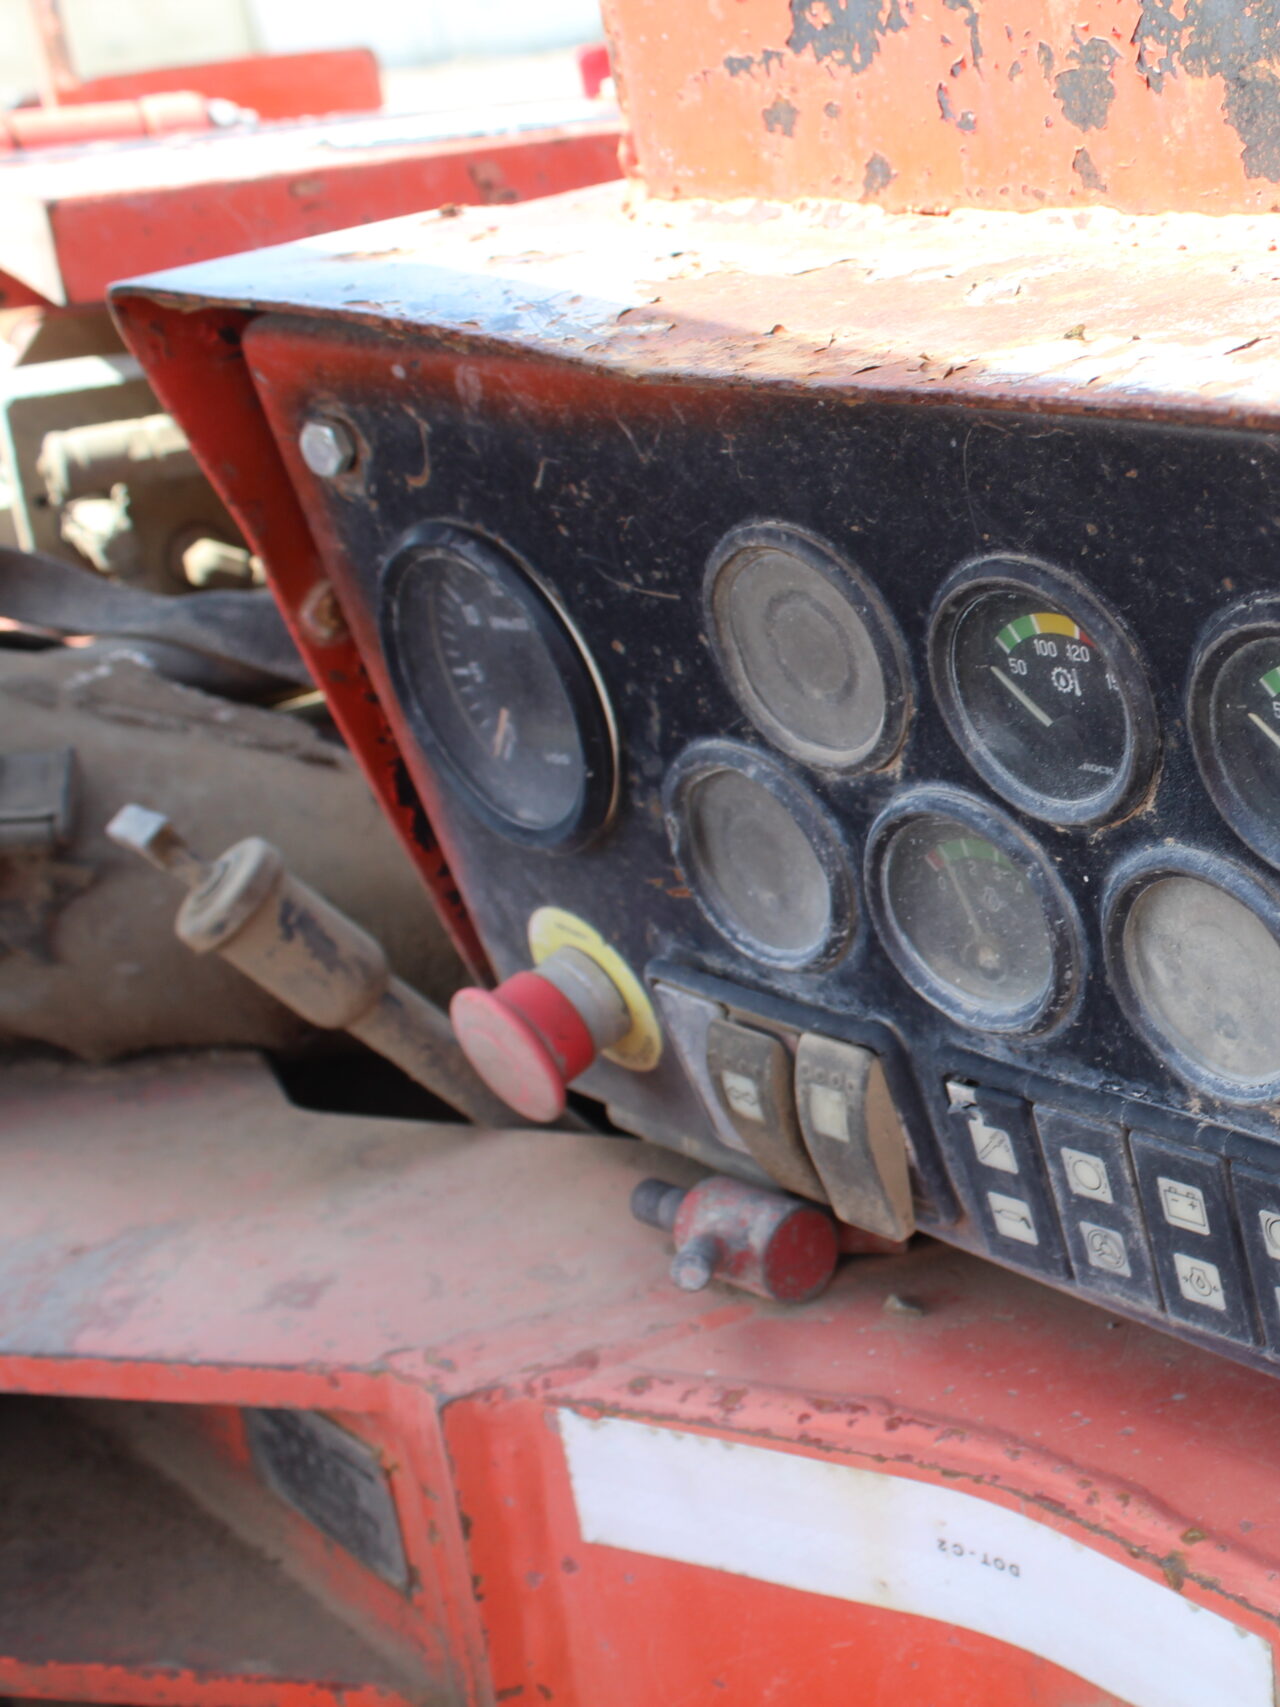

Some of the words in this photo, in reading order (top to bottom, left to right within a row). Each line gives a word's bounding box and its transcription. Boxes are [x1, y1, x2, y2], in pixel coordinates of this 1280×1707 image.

[1033, 638, 1058, 658] 100
[1065, 643, 1090, 662] 120
[1008, 657, 1028, 676] 50
[937, 1538, 1021, 1578] DOT-C2
